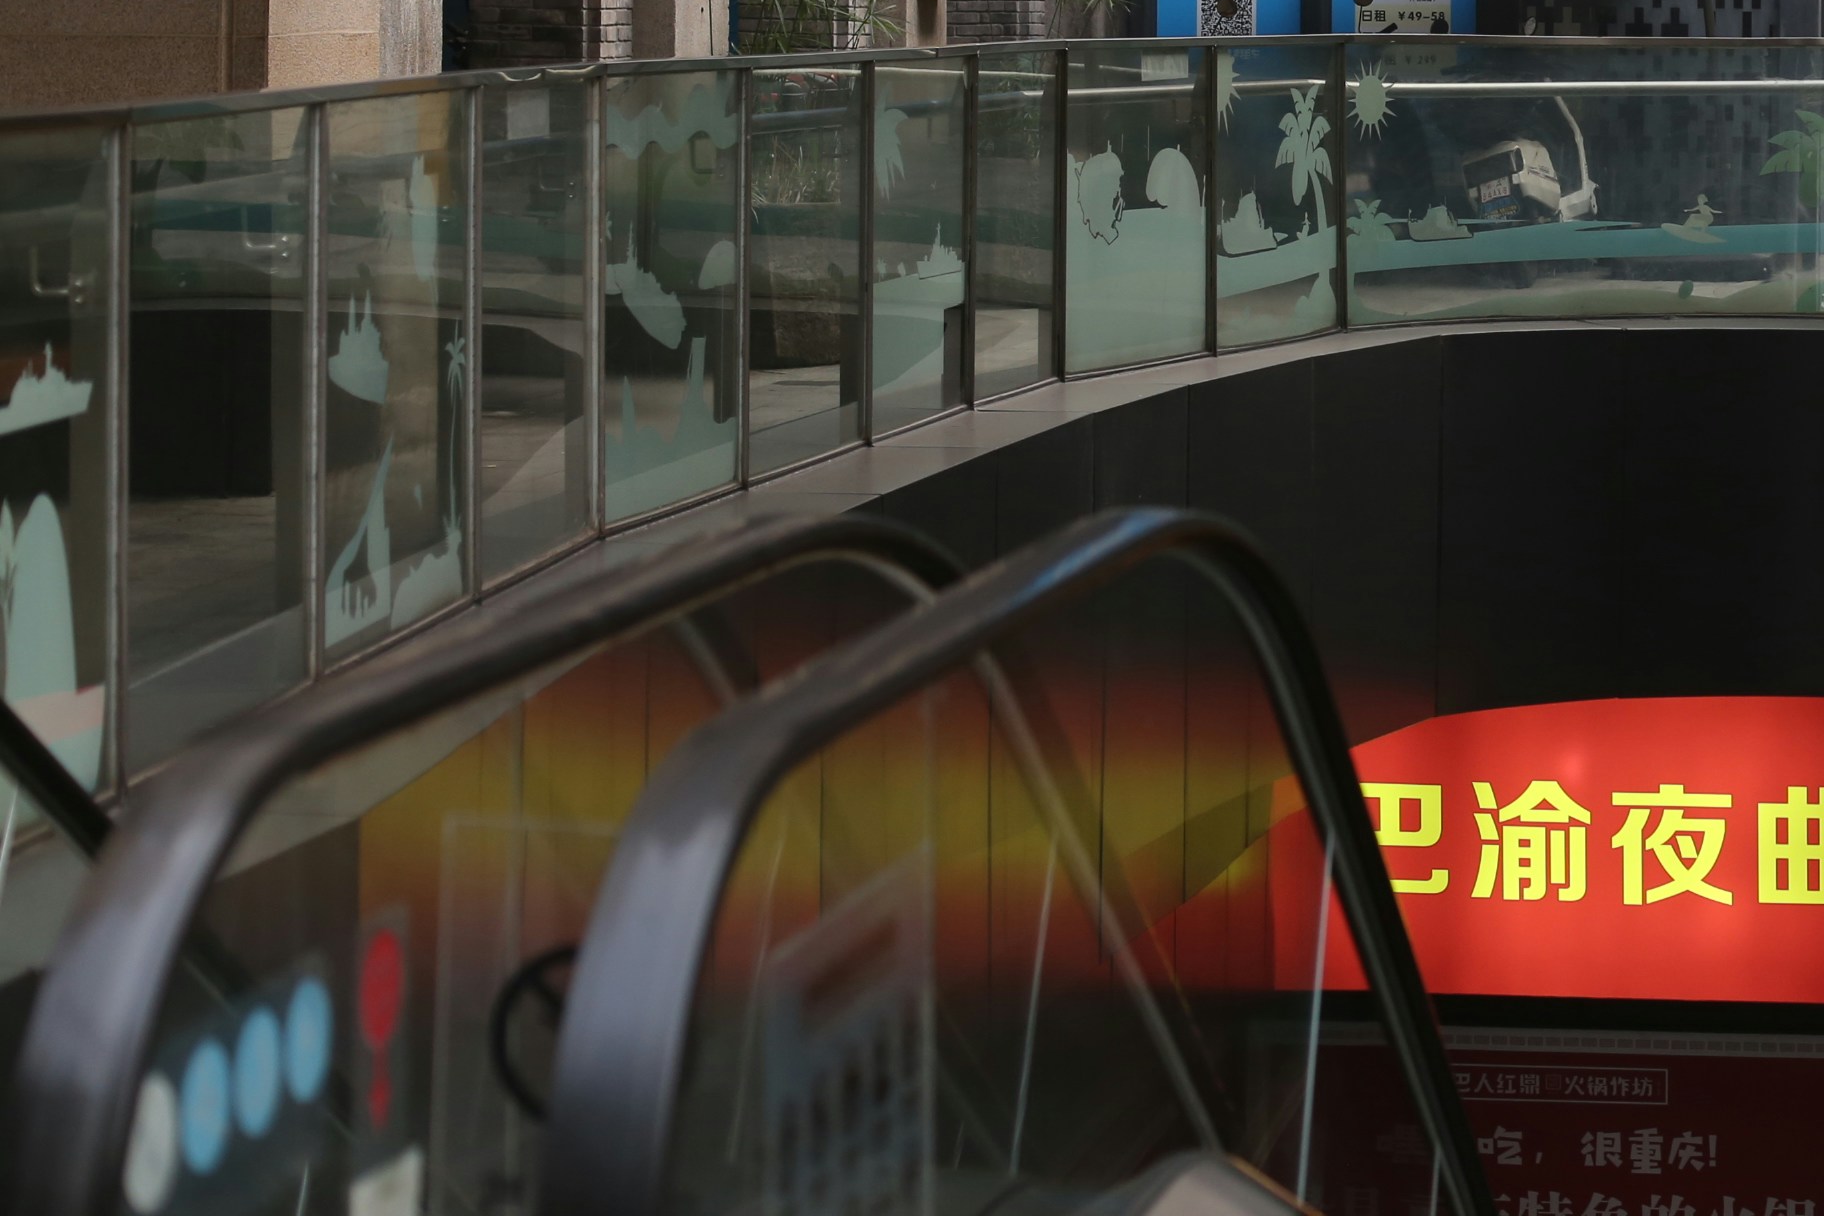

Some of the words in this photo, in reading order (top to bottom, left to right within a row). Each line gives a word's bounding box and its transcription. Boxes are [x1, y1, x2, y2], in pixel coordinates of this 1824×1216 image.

[1362, 10, 1386, 22] 日租
[1564, 1074, 1654, 1097] 火锅作坊
